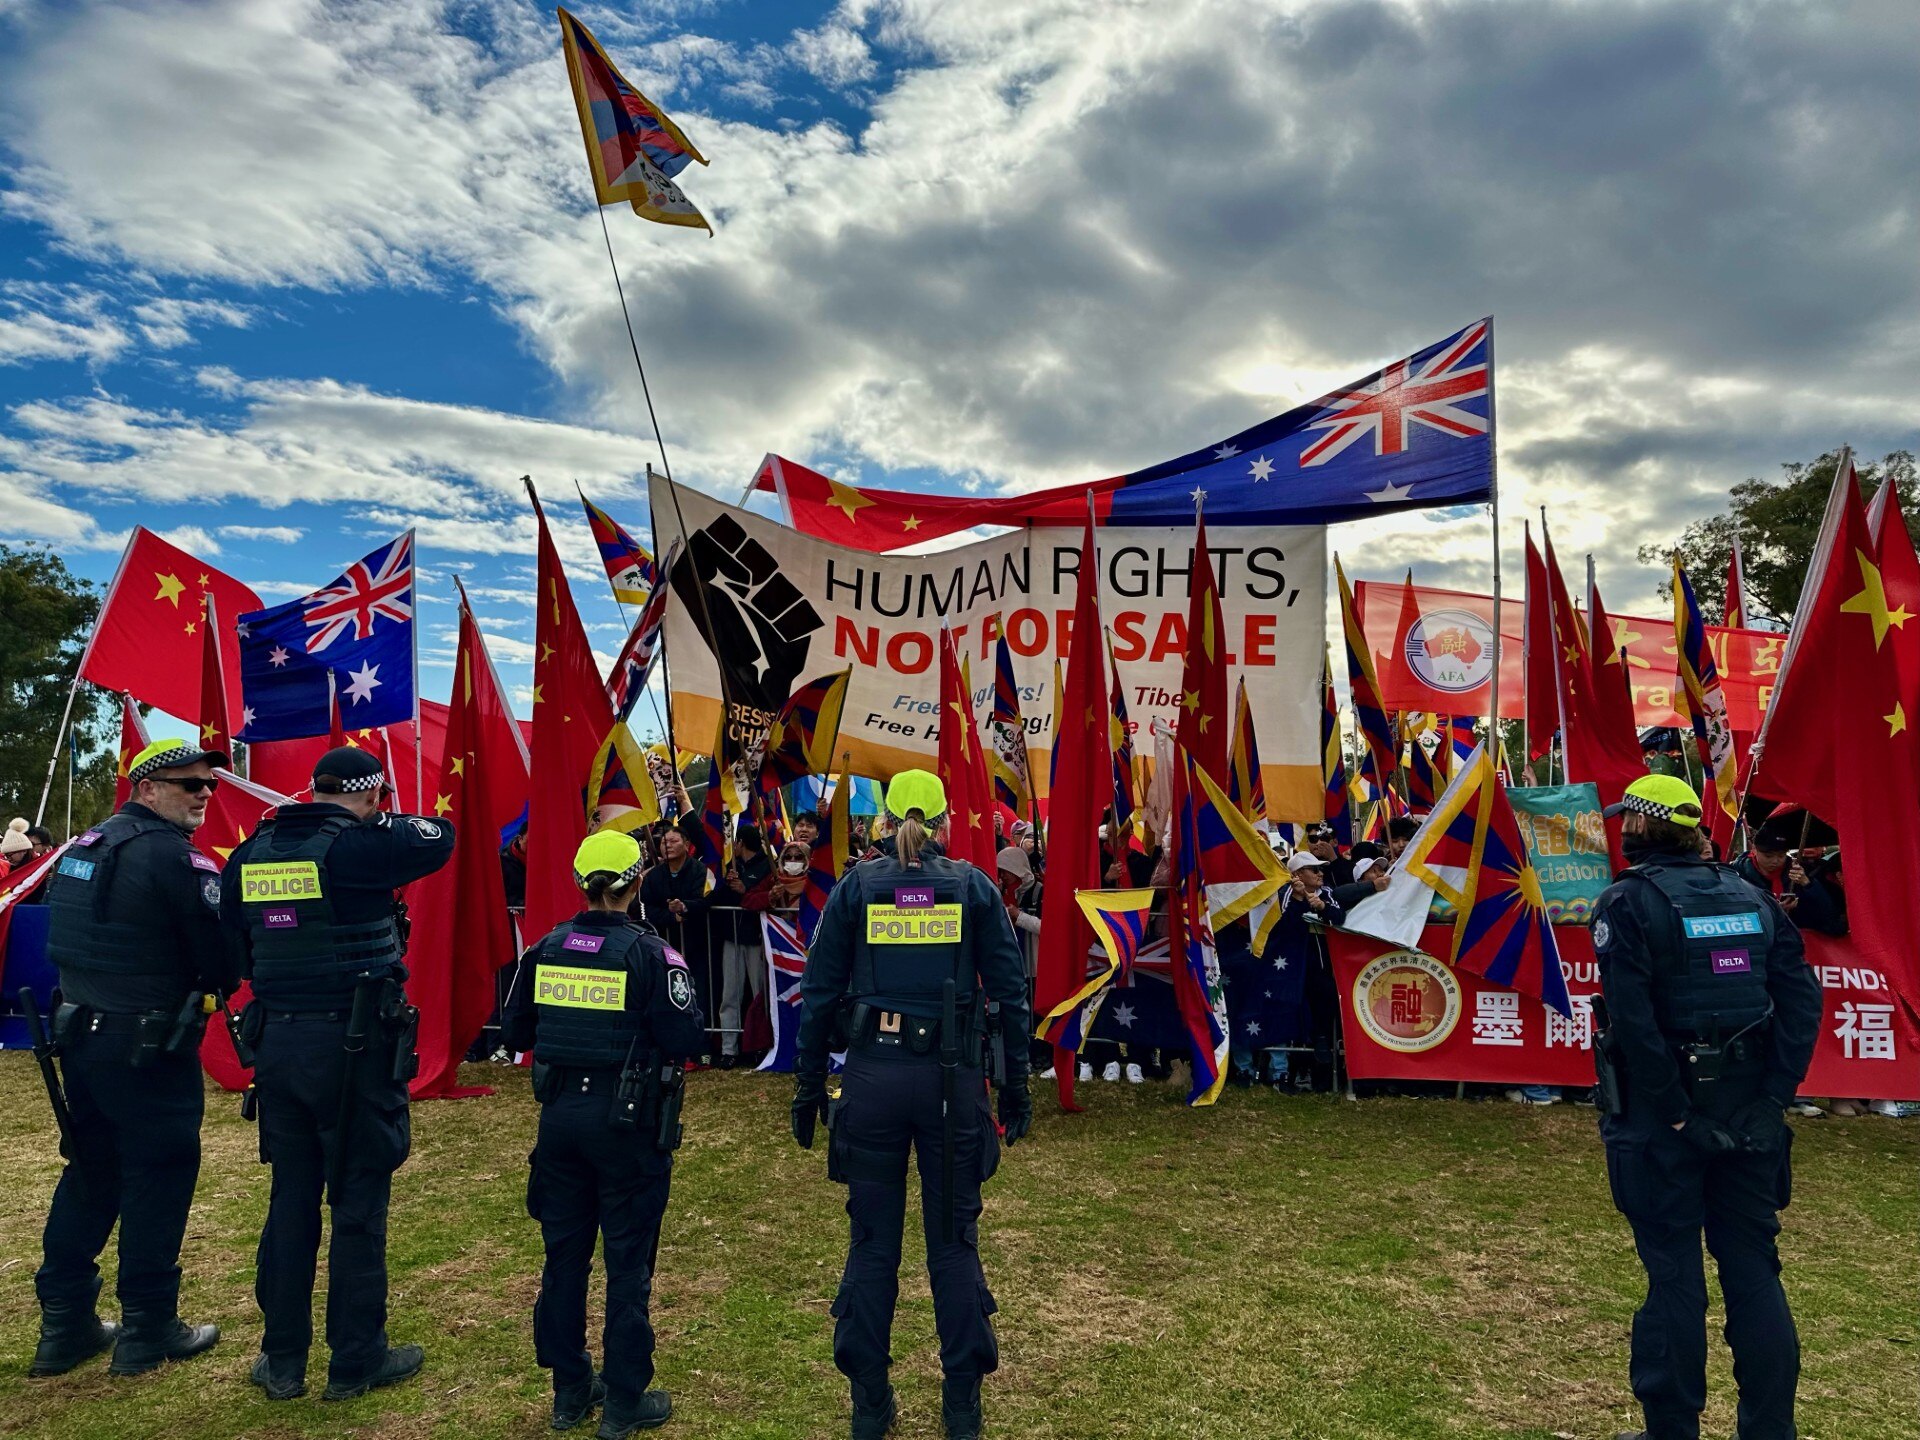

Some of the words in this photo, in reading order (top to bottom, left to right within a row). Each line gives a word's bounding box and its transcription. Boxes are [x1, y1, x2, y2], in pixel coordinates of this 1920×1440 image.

[826, 547, 1030, 618] HUMAN
[1053, 546, 1300, 607] RGHTS,
[1113, 611, 1277, 666] SAE
[1437, 671, 1466, 682] AFA
[893, 694, 940, 715] Free
[1134, 686, 1183, 708] Tibe
[865, 713, 916, 736] Free
[246, 868, 284, 876] AUSTRALIAN
[1537, 861, 1608, 883] ciation
[246, 878, 316, 896] POLICE
[902, 894, 929, 902] DELTA
[269, 914, 292, 922] DELTA
[870, 920, 958, 938] POLICE
[1691, 920, 1755, 935] POLICE
[571, 938, 596, 948] DELTA
[1719, 957, 1745, 967] DELTA
[541, 971, 587, 982] AUSTRALIAN
[588, 974, 621, 983] FEDERAL
[539, 982, 621, 1004] POLICE
[1834, 1001, 1897, 1060] 福
